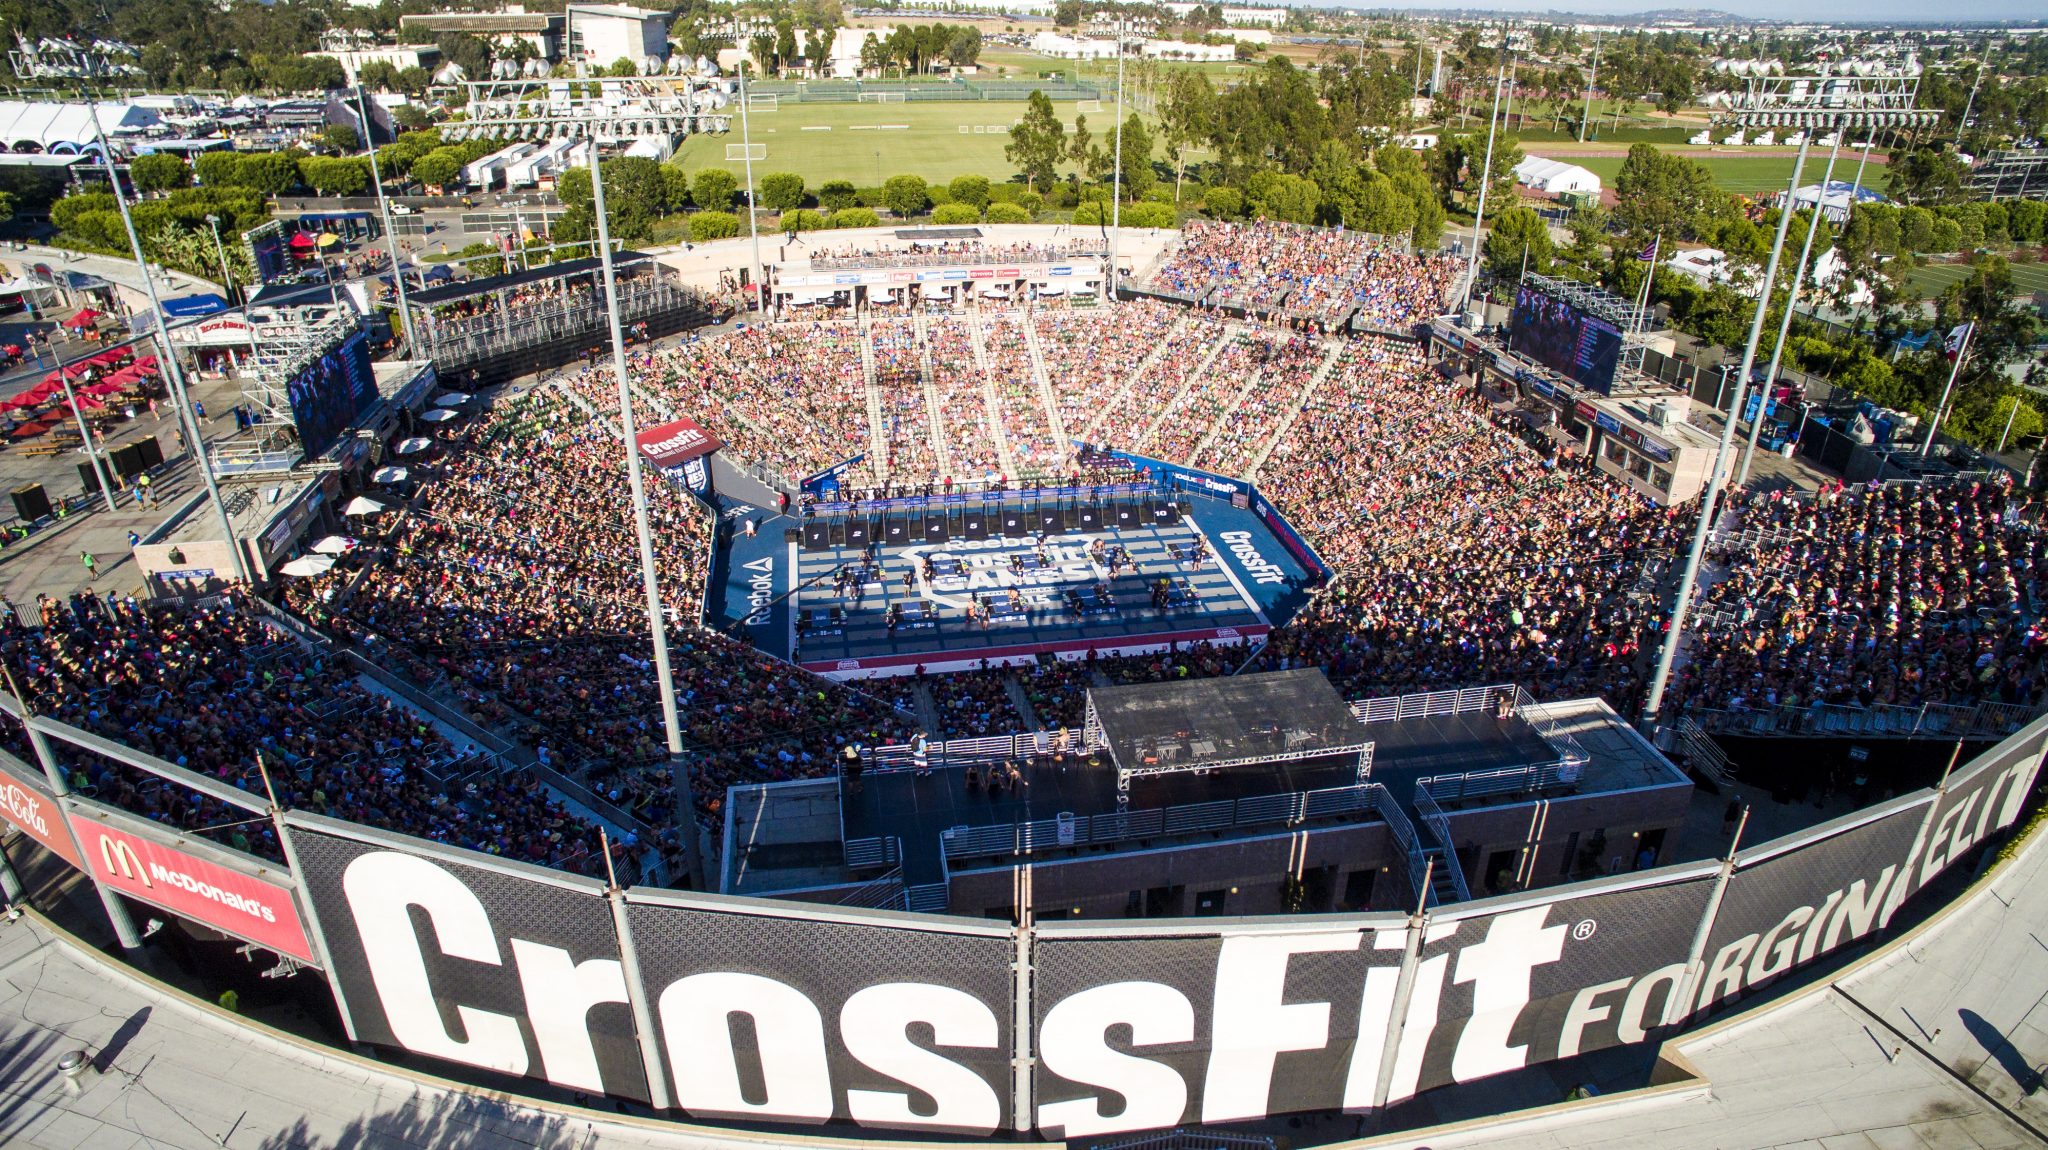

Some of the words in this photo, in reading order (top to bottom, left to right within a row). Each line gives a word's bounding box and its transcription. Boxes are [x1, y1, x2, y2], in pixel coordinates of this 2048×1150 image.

[641, 429, 703, 455] CrossFit
[1219, 530, 1285, 585] CrossFit
[745, 574, 772, 625] Reebok
[150, 861, 276, 923] McDonald's
[343, 850, 1569, 1143] CrossFit
